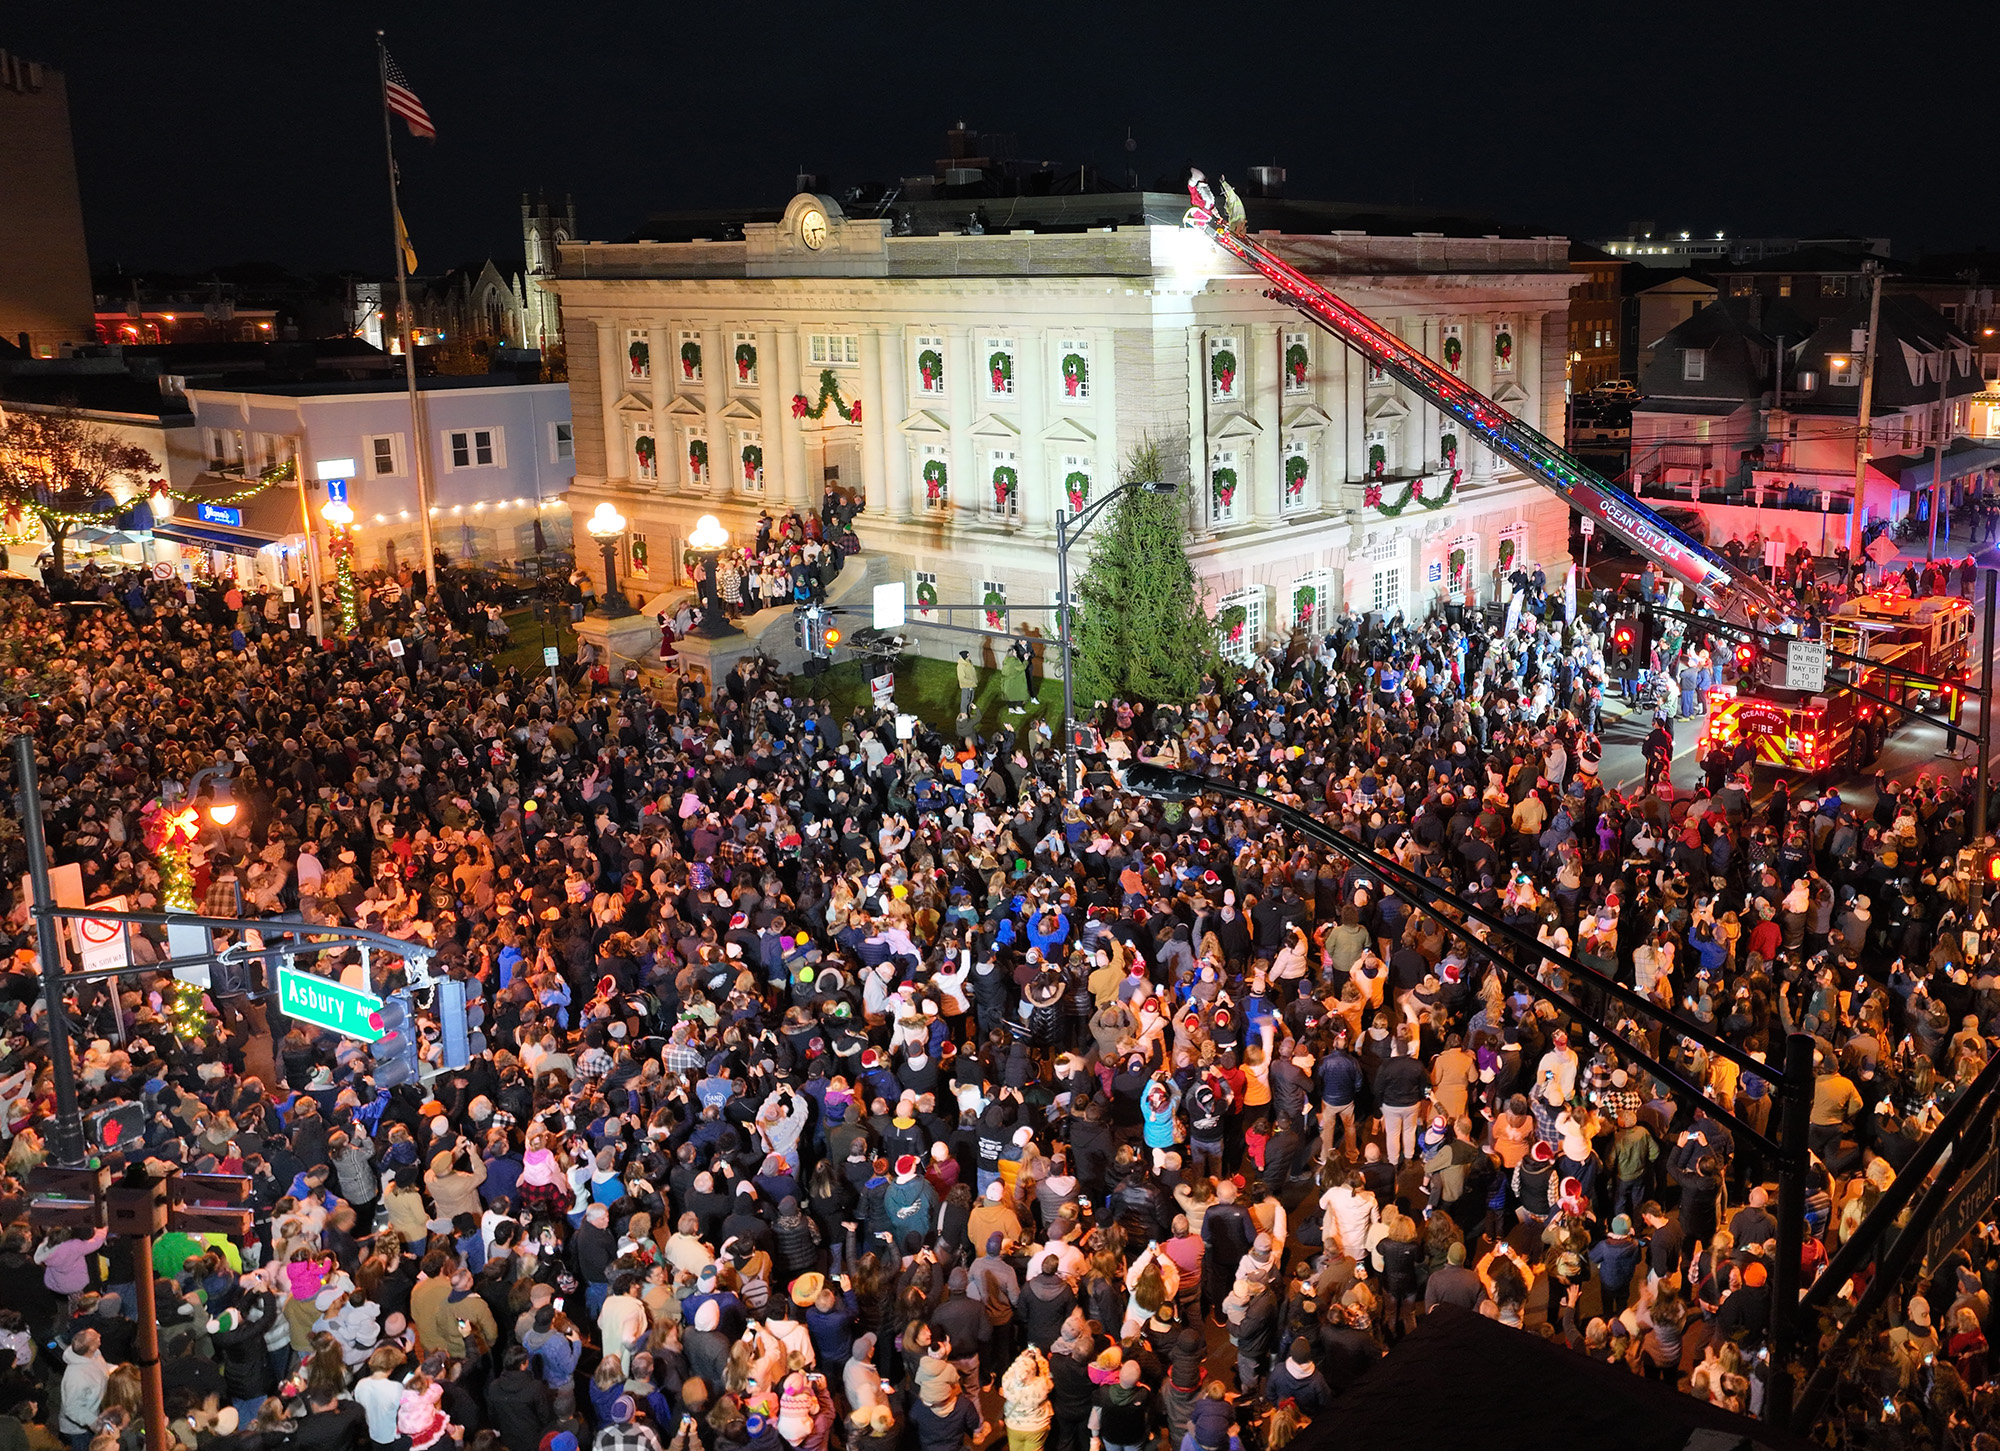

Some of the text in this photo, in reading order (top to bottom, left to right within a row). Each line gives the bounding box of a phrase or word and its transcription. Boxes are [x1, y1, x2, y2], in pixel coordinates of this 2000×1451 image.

[819, 297, 857, 309] HALL
[1600, 500, 1679, 561] OCEAN CITY N.J.
[1804, 646, 1822, 654] TURN
[1741, 710, 1784, 725] OCEAN CITY
[1752, 723, 1773, 734] FIRE
[289, 979, 344, 1023] Asbury
[1959, 1169, 1992, 1229] Street
